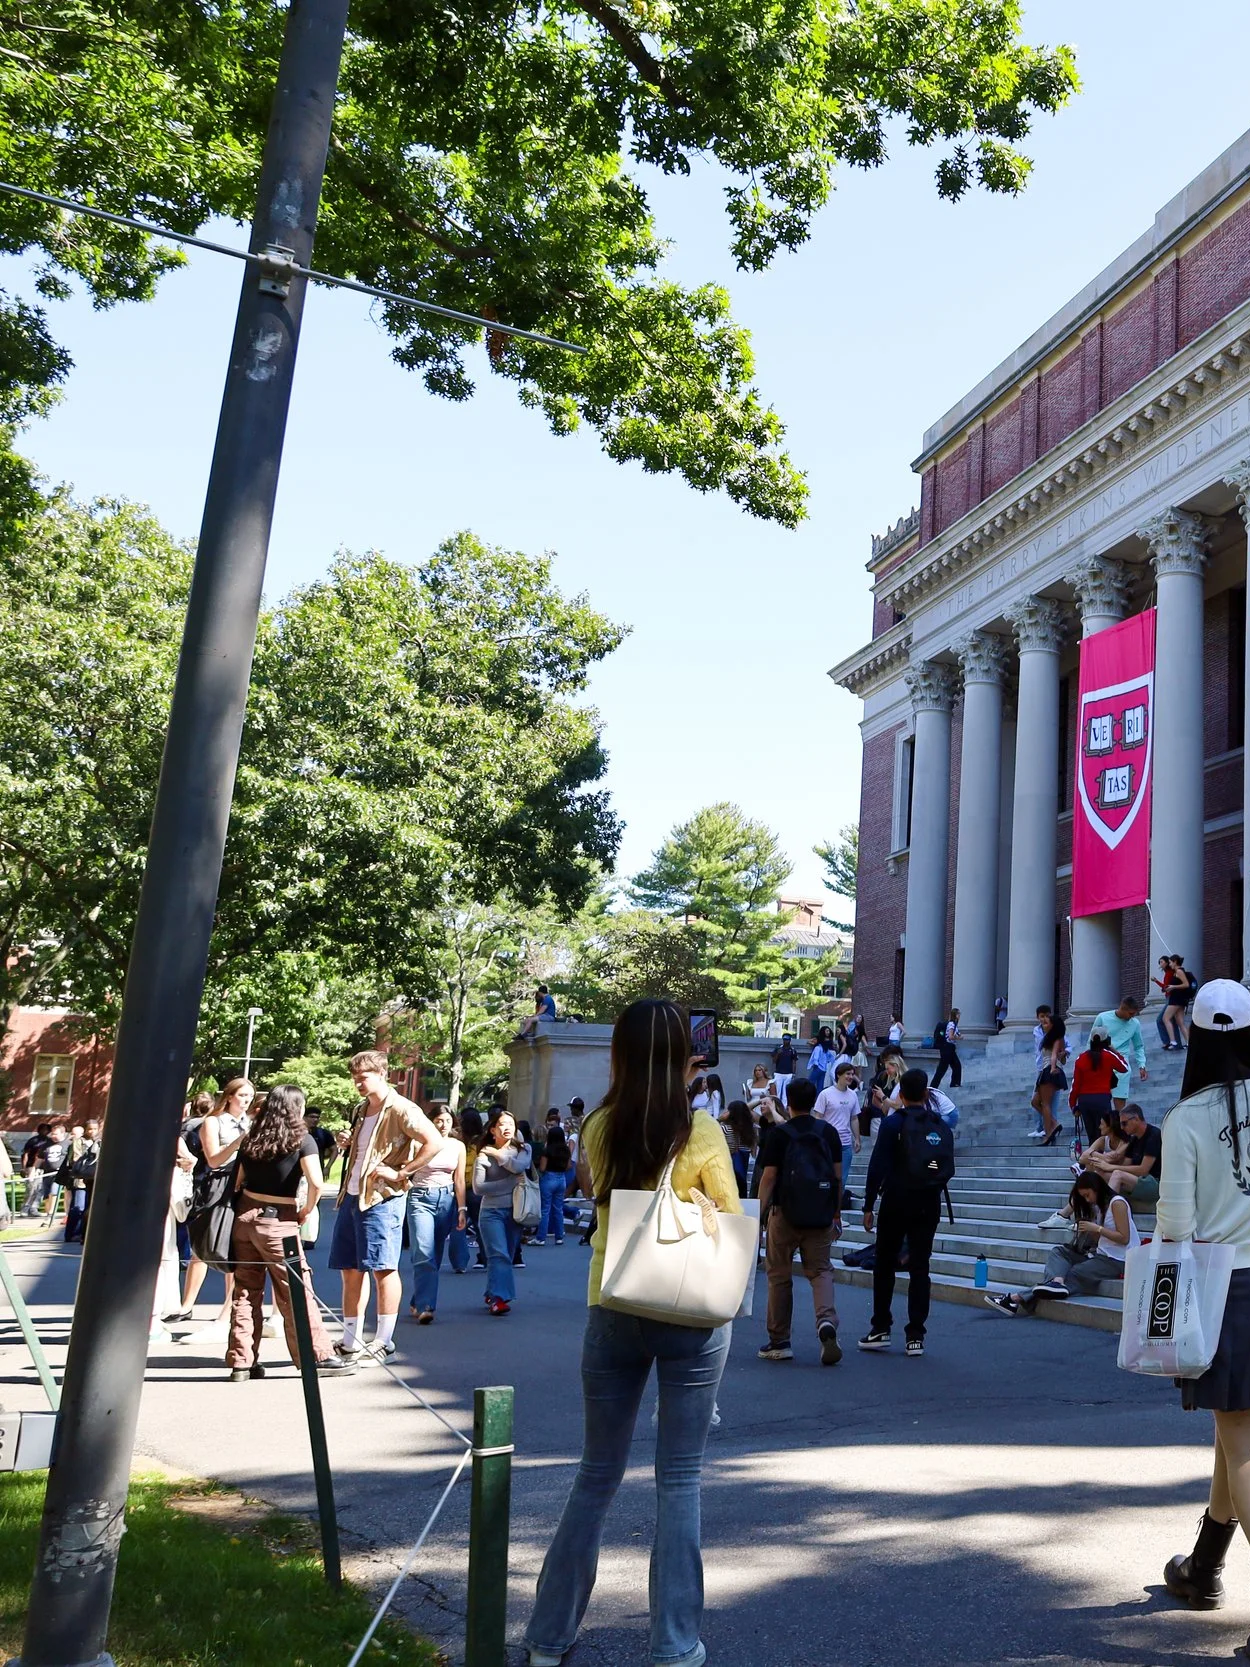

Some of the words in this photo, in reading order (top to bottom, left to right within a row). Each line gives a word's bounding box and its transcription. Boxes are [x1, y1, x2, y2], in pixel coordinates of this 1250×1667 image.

[946, 584, 974, 617] THE
[985, 538, 1042, 593] HARRY
[1055, 483, 1126, 547] ELKINS
[1092, 725, 1108, 742] VE
[1127, 716, 1139, 736] RI
[1107, 775, 1127, 794] TAS
[1160, 1267, 1176, 1276] THE
[1153, 1277, 1173, 1333] COOP
[1183, 1279, 1193, 1325] thecoop.com
